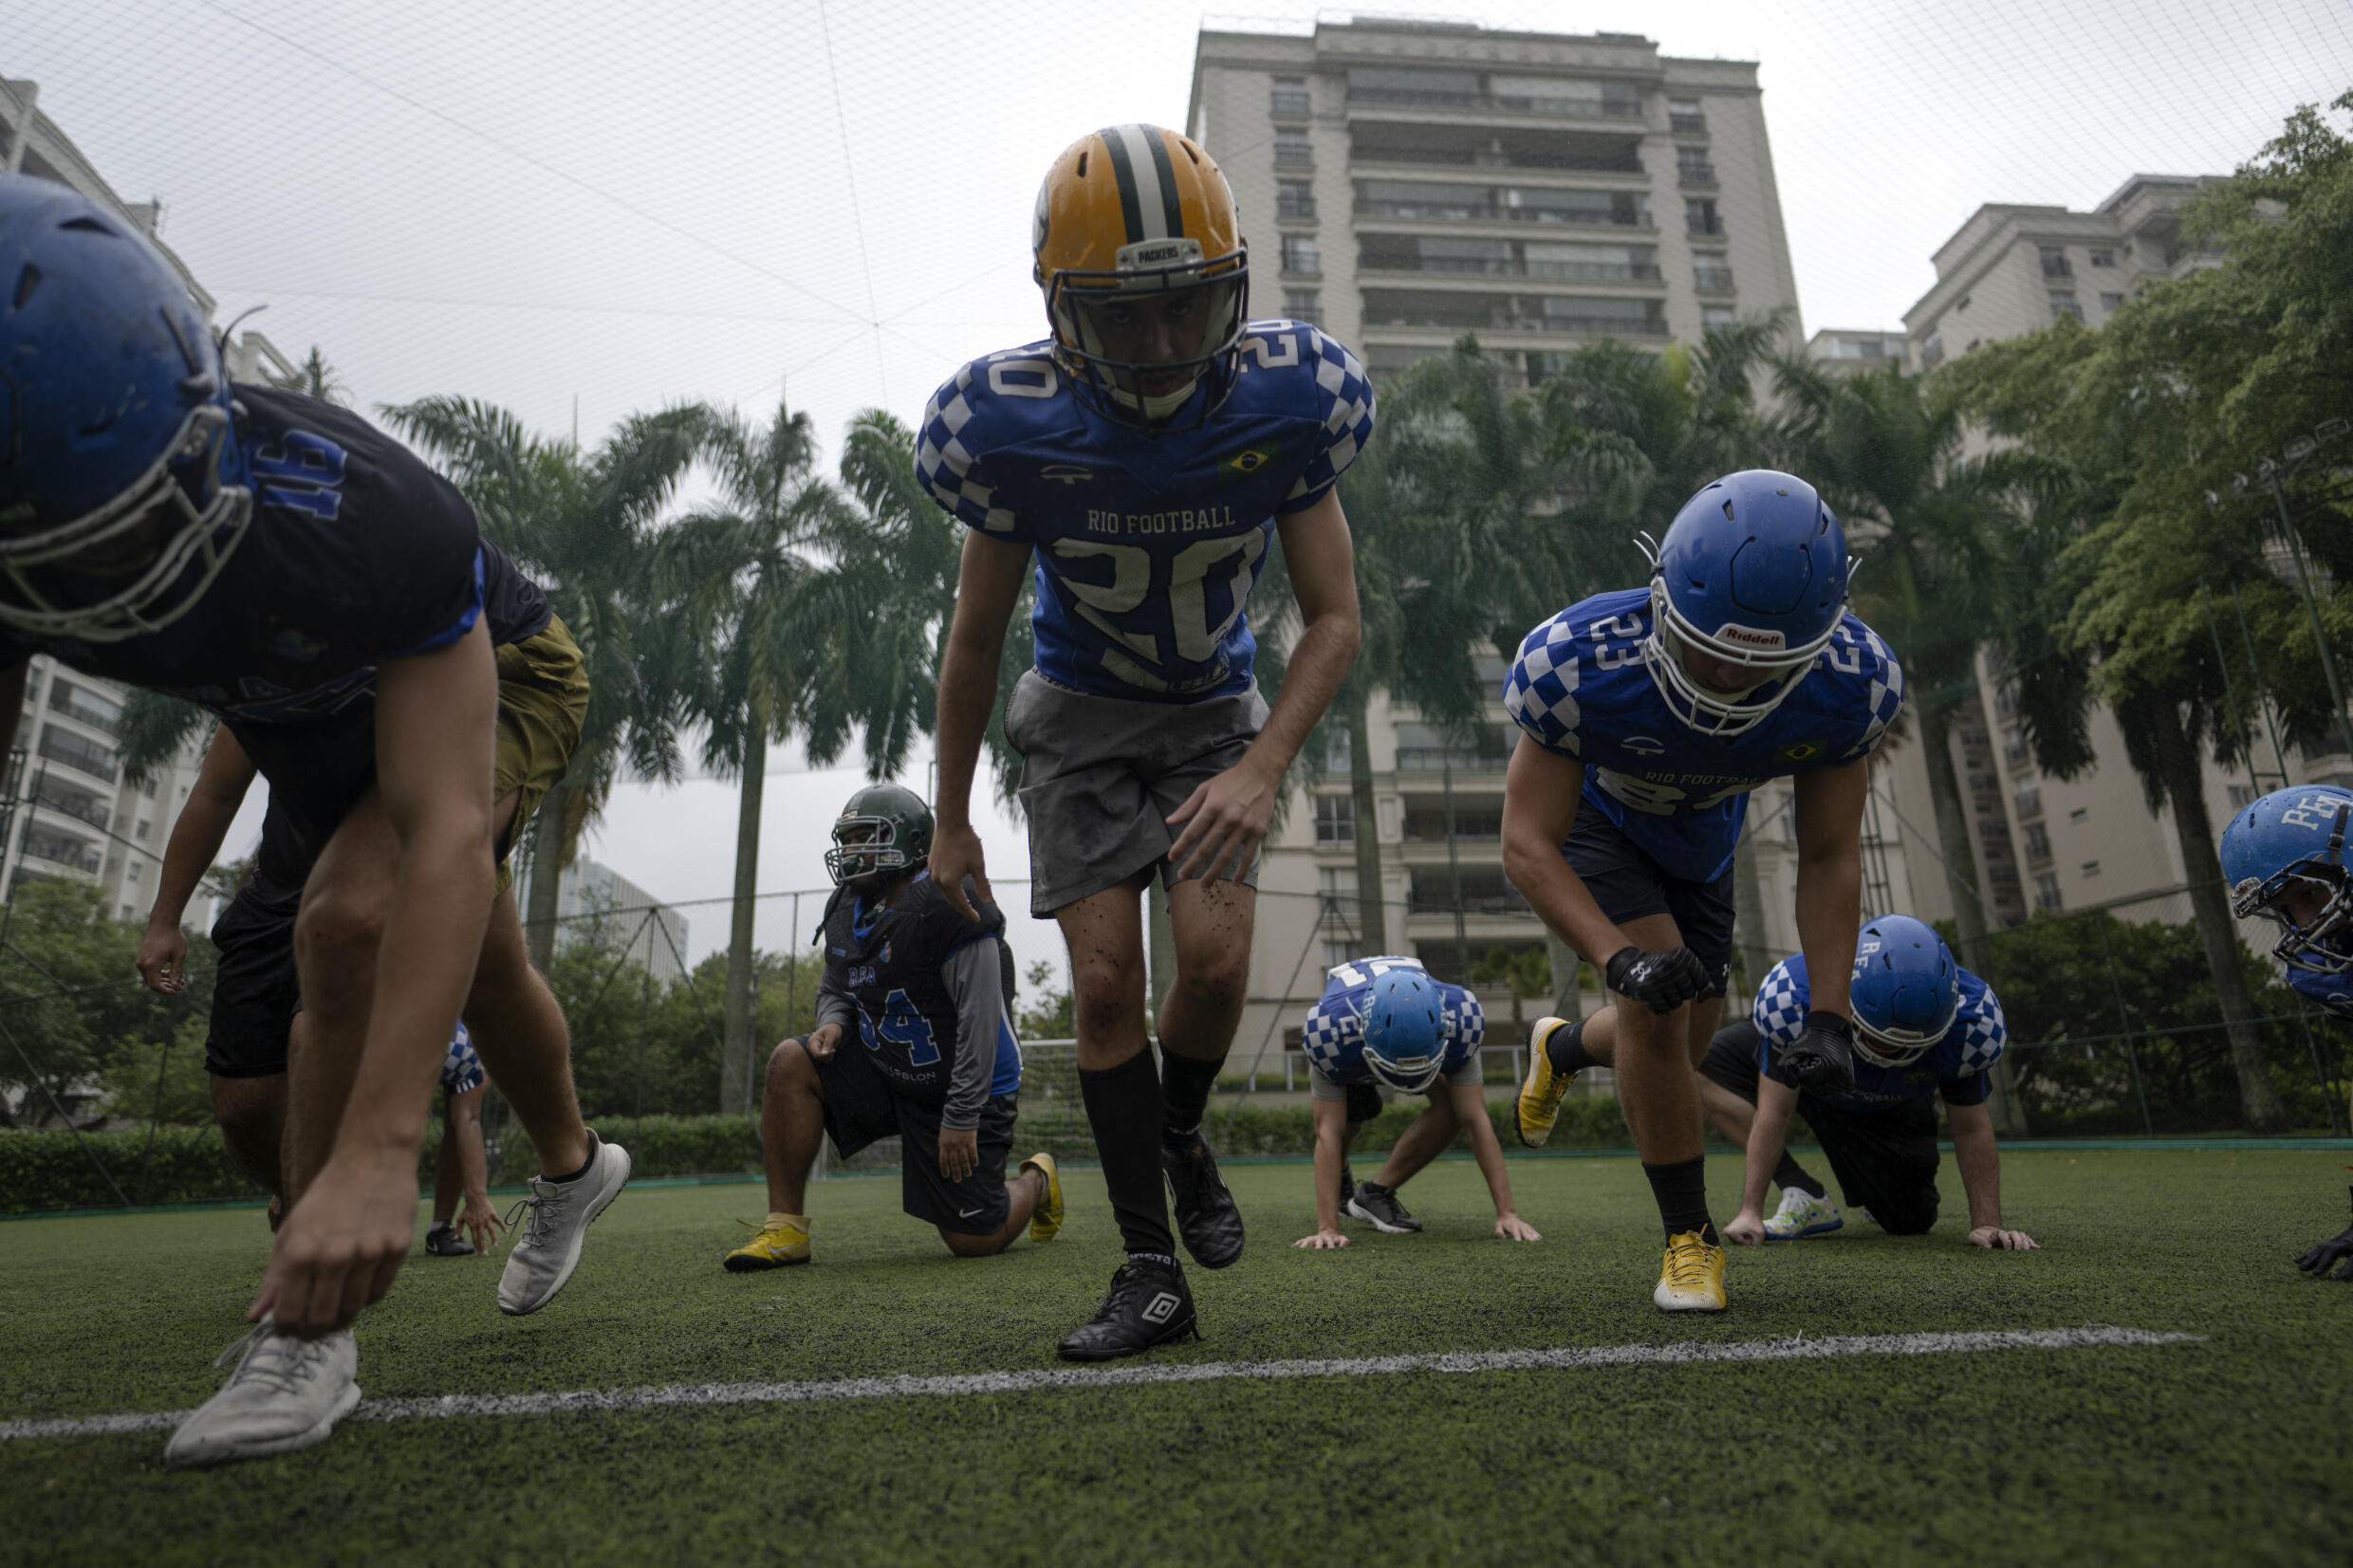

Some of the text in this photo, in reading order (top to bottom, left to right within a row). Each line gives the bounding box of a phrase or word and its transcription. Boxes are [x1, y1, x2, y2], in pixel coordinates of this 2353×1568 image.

[1138, 245, 1179, 264] PACKERS
[1087, 506, 1236, 535] RIO FOOTBALL
[1051, 526, 1267, 693] 20
[1589, 613, 1646, 672] 23
[1726, 627, 1780, 647] Riddell
[1644, 771, 1677, 784] RIO
[848, 965, 877, 987] RFA
